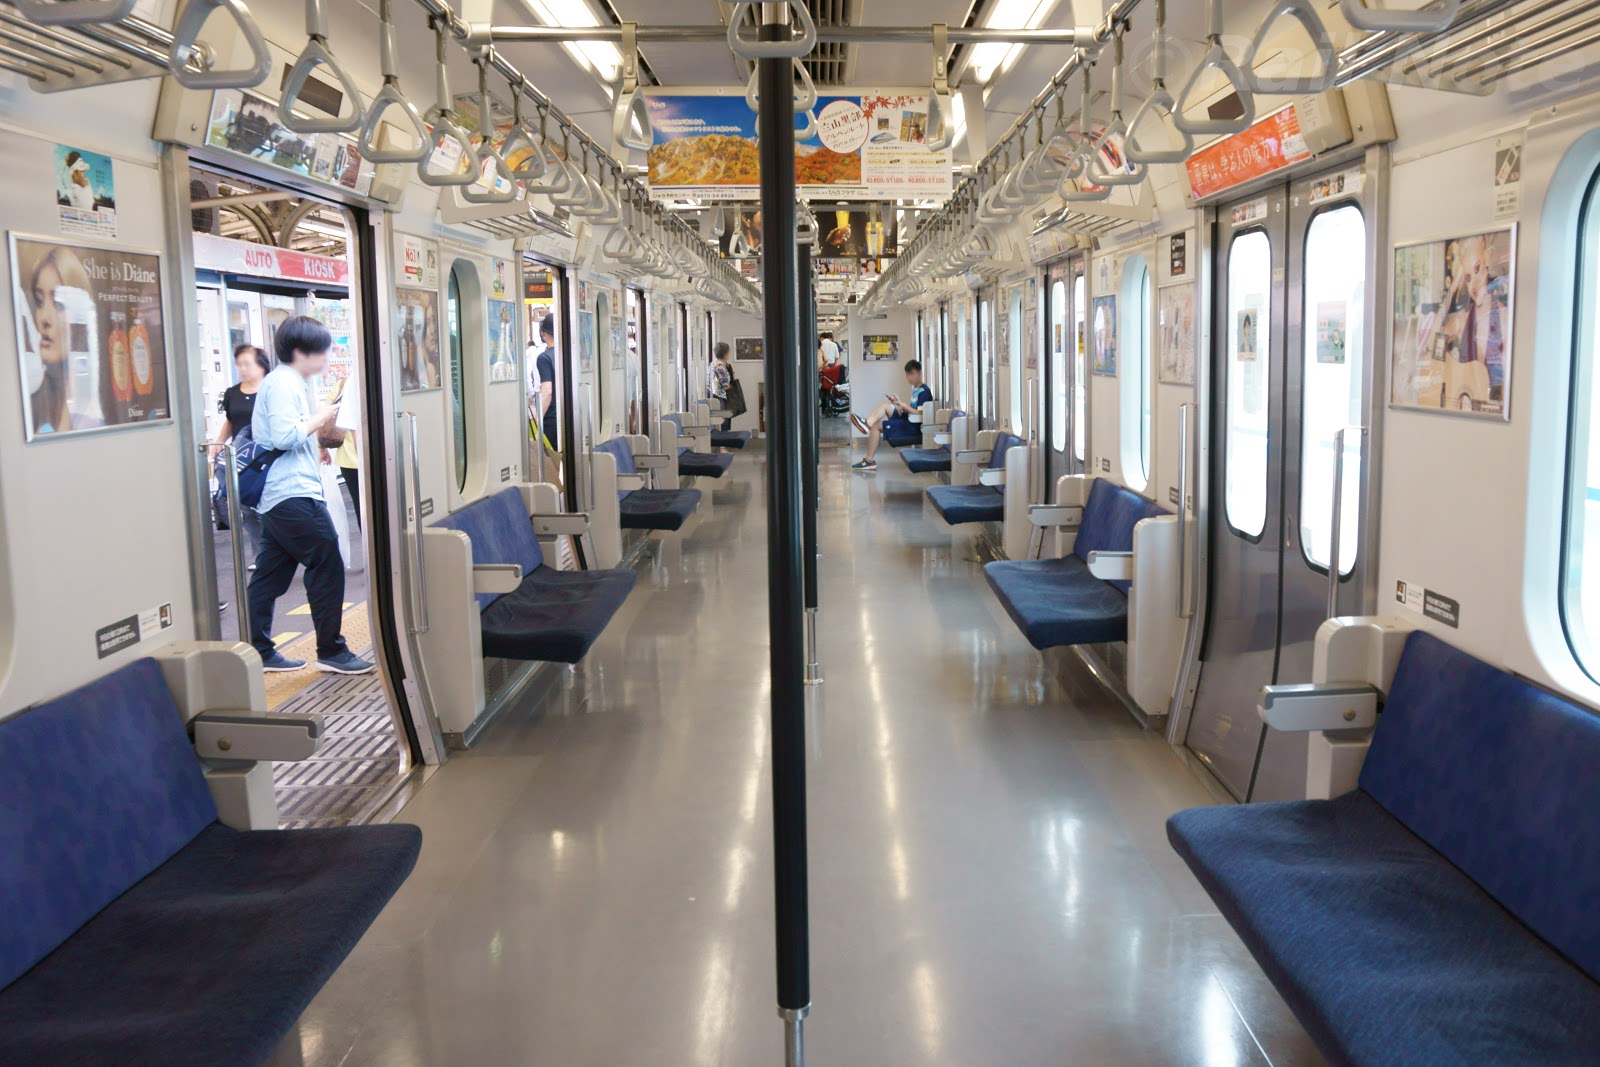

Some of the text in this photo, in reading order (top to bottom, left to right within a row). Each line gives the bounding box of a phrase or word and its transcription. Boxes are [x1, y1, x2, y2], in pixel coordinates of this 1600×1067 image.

[820, 111, 862, 133] 立山黒部
[83, 257, 108, 280] She
[110, 261, 121, 281] is
[245, 249, 336, 279] AUTO KIOSK
[98, 292, 153, 303] PERFECT BEAUTY
